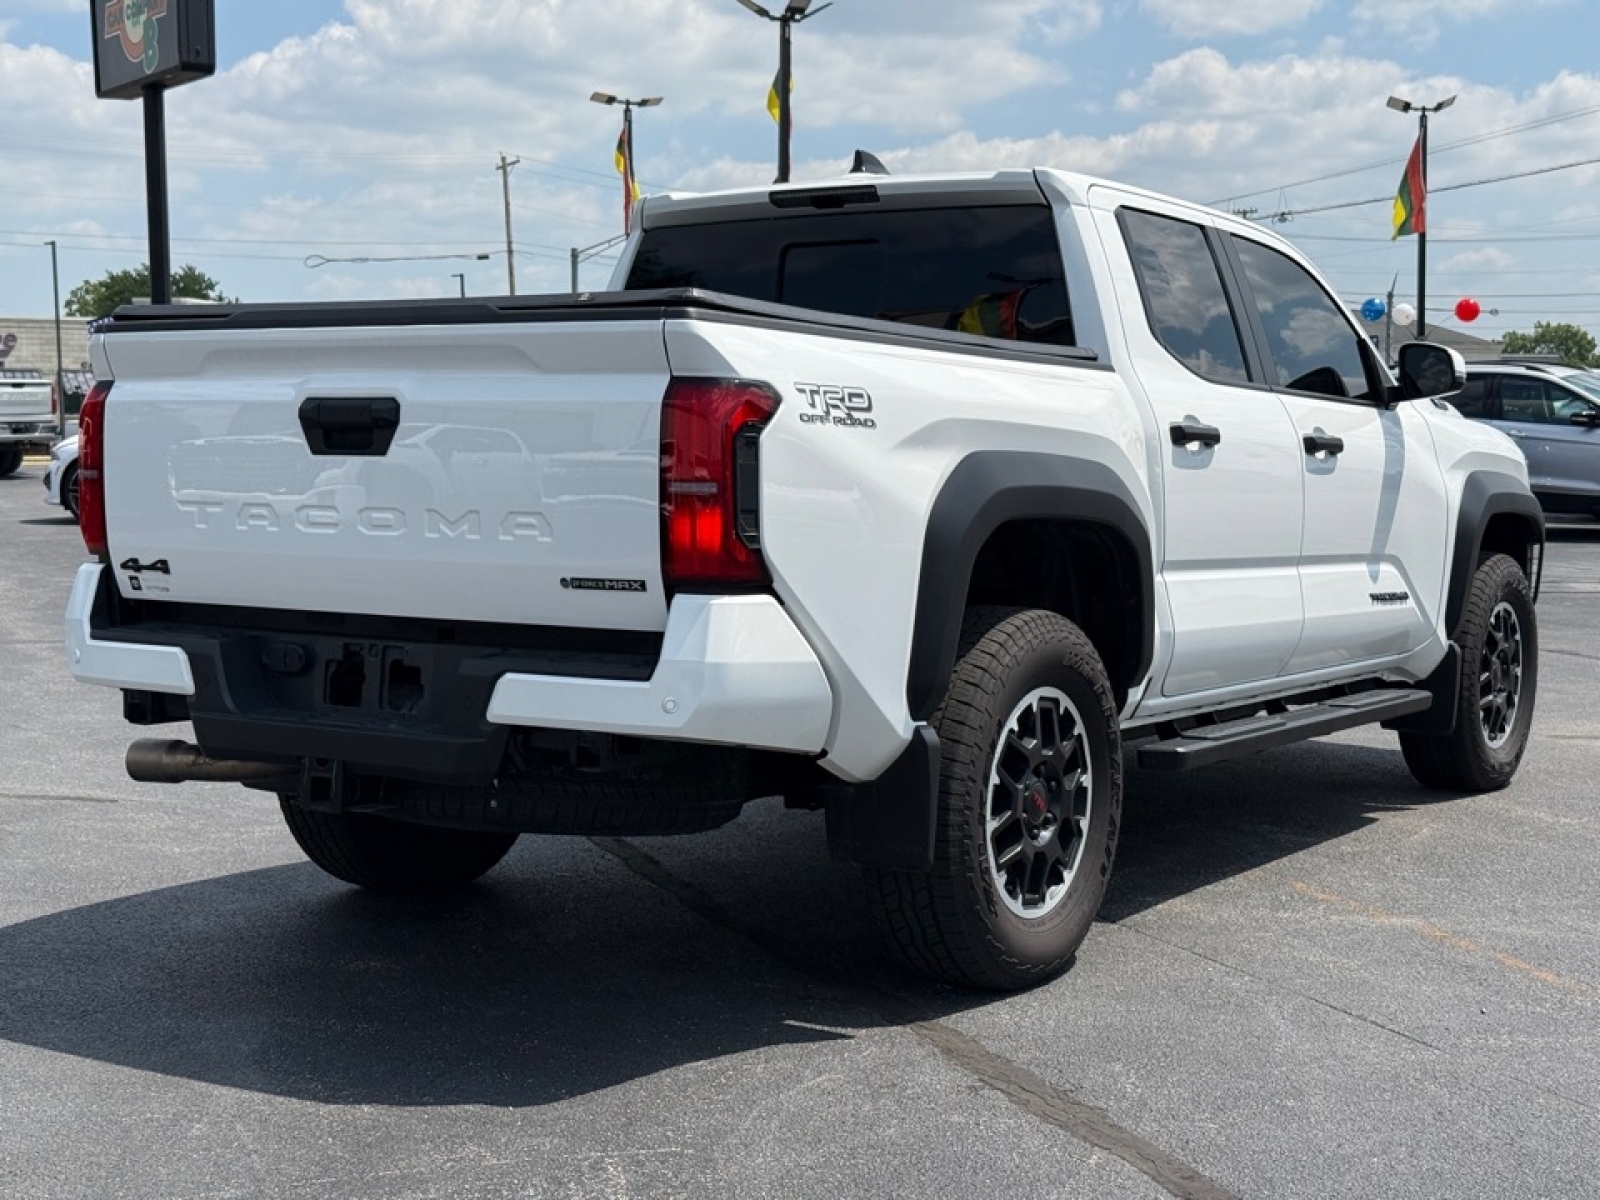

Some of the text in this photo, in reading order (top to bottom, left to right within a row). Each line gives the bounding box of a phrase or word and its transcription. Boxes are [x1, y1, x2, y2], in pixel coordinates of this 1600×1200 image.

[793, 382, 873, 418] TRD
[799, 412, 877, 430] OFF ROAD
[176, 501, 553, 542] TACOMA
[604, 580, 643, 591] MAX
